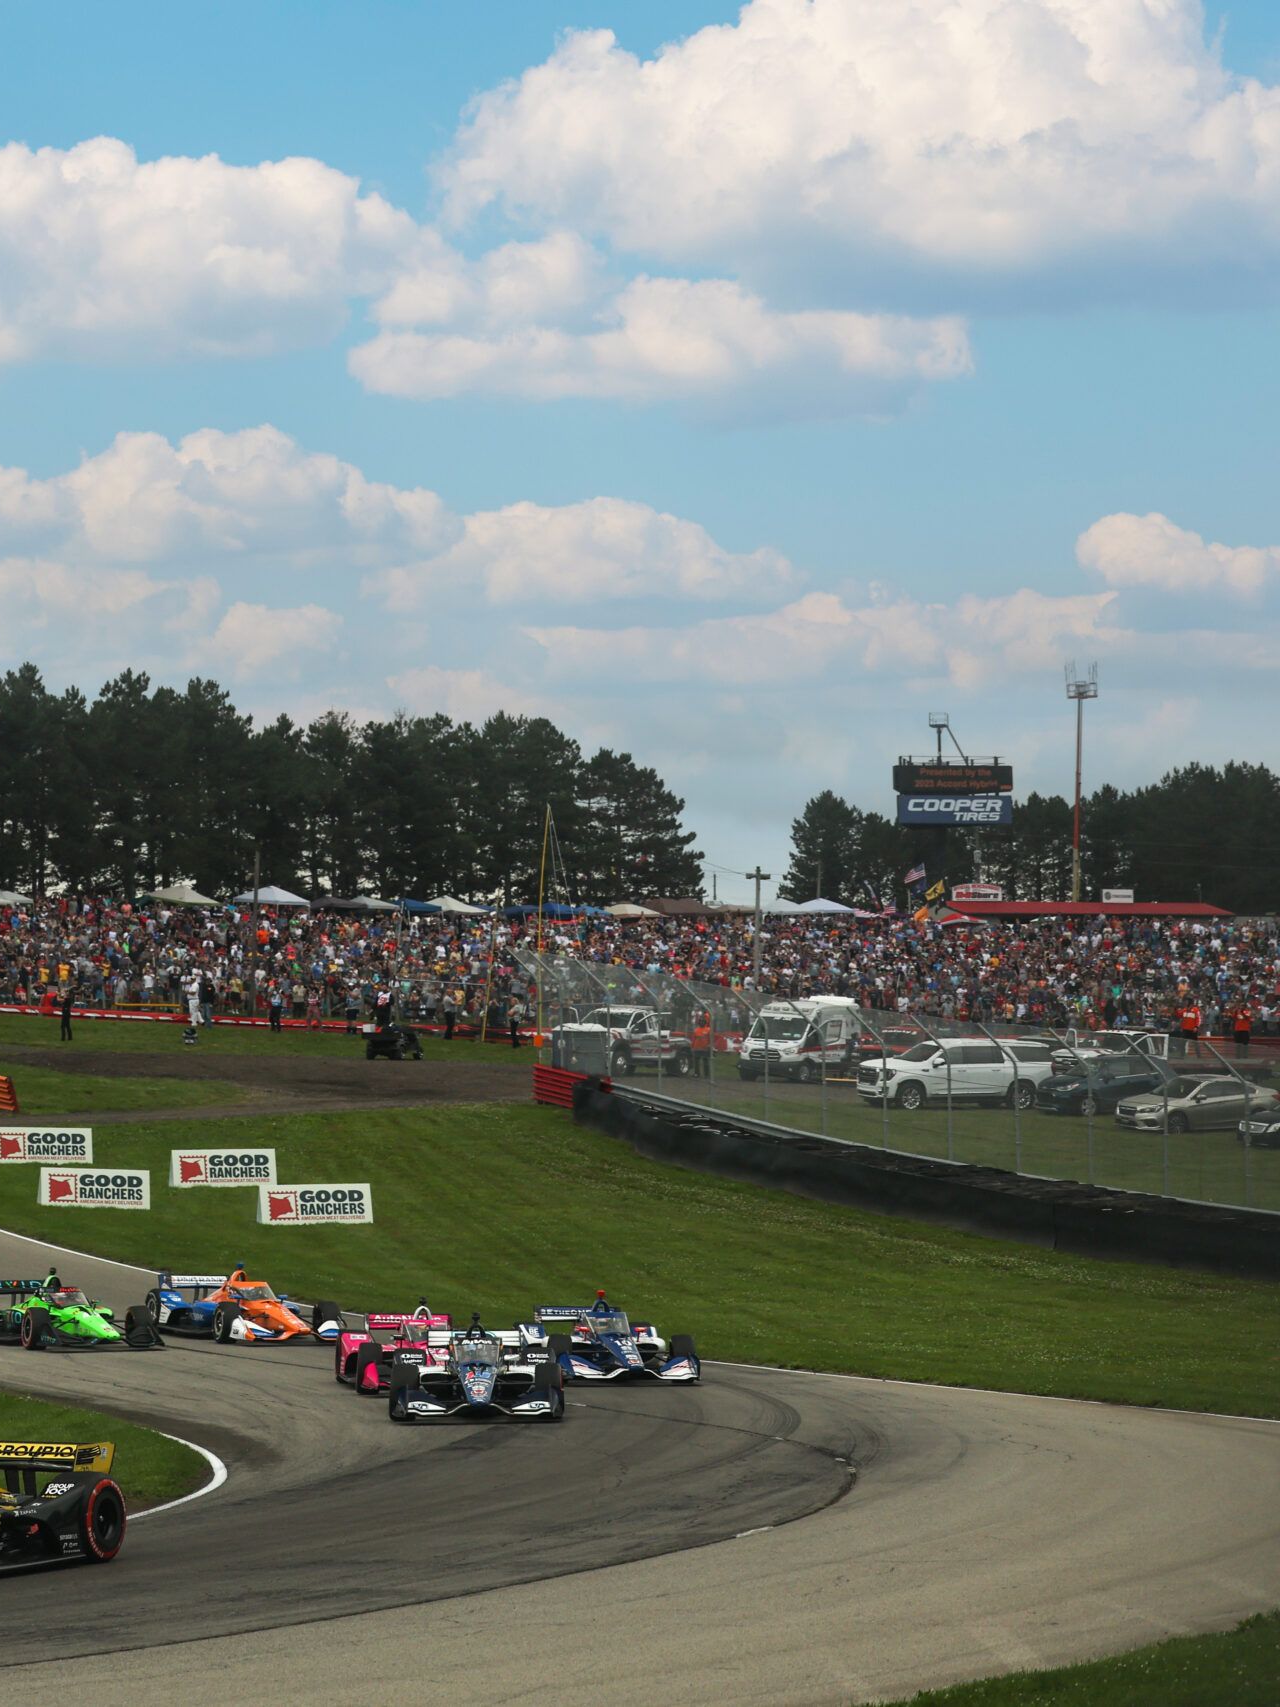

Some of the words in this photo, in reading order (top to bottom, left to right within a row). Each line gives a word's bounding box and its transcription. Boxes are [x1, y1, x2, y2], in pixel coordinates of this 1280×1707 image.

[907, 798, 1003, 812] COOPER
[953, 812, 1001, 821] TIRES
[27, 1132, 86, 1145] GOOD
[27, 1144, 86, 1156] RANCHERS
[209, 1154, 269, 1167] GOOD
[209, 1166, 270, 1178] RANCHERS
[79, 1174, 143, 1188] GOOD
[79, 1187, 143, 1201] RANCHERS
[299, 1190, 364, 1203] GOOD
[300, 1202, 365, 1215] RANCHERS
